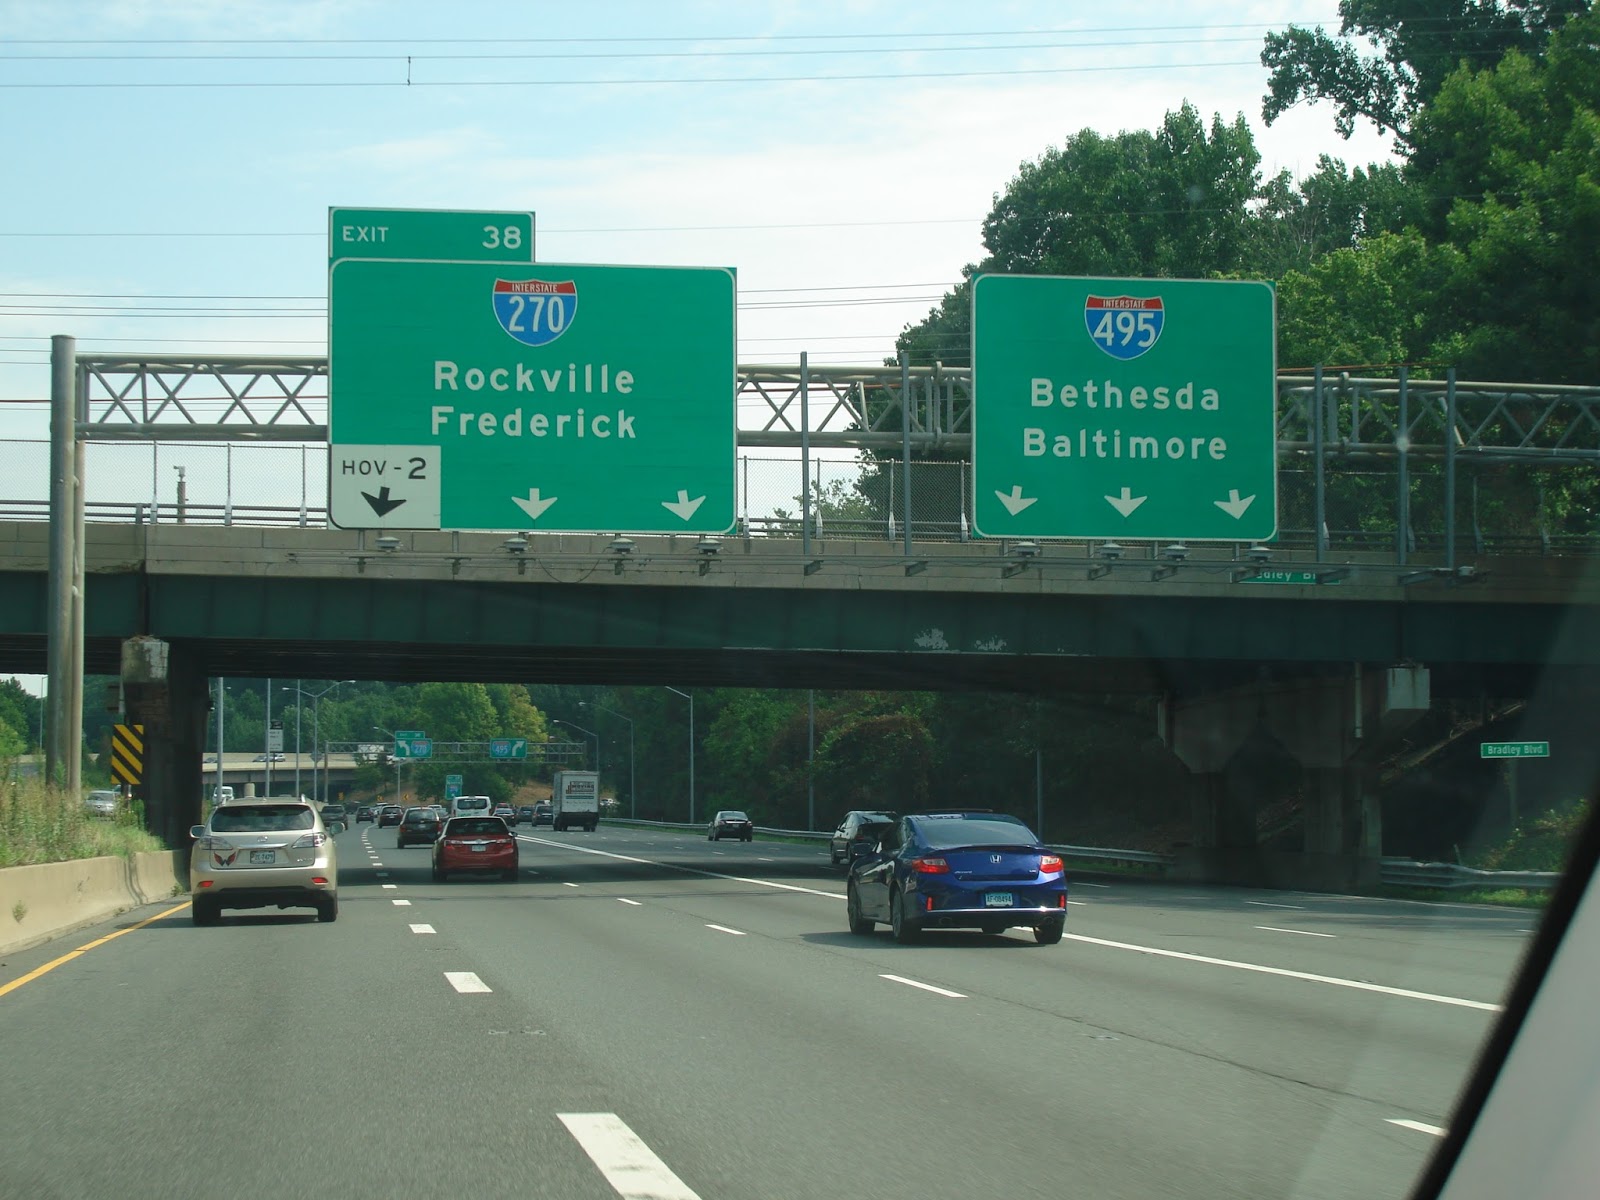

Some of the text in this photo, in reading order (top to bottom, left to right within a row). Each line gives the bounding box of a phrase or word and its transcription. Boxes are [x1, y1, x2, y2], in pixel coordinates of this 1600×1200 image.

[342, 225, 522, 249] EXIT 38
[511, 283, 558, 293] INTERSTATE
[1103, 299, 1146, 309] INTERSTATE
[508, 295, 565, 333] 270
[1093, 311, 1156, 348] 495
[434, 361, 635, 394] Rockville
[1031, 378, 1220, 411] Bethesda
[431, 406, 636, 439] Frederick
[1023, 428, 1227, 460] Baltimore
[1487, 744, 1543, 756] Bradley Blvd
